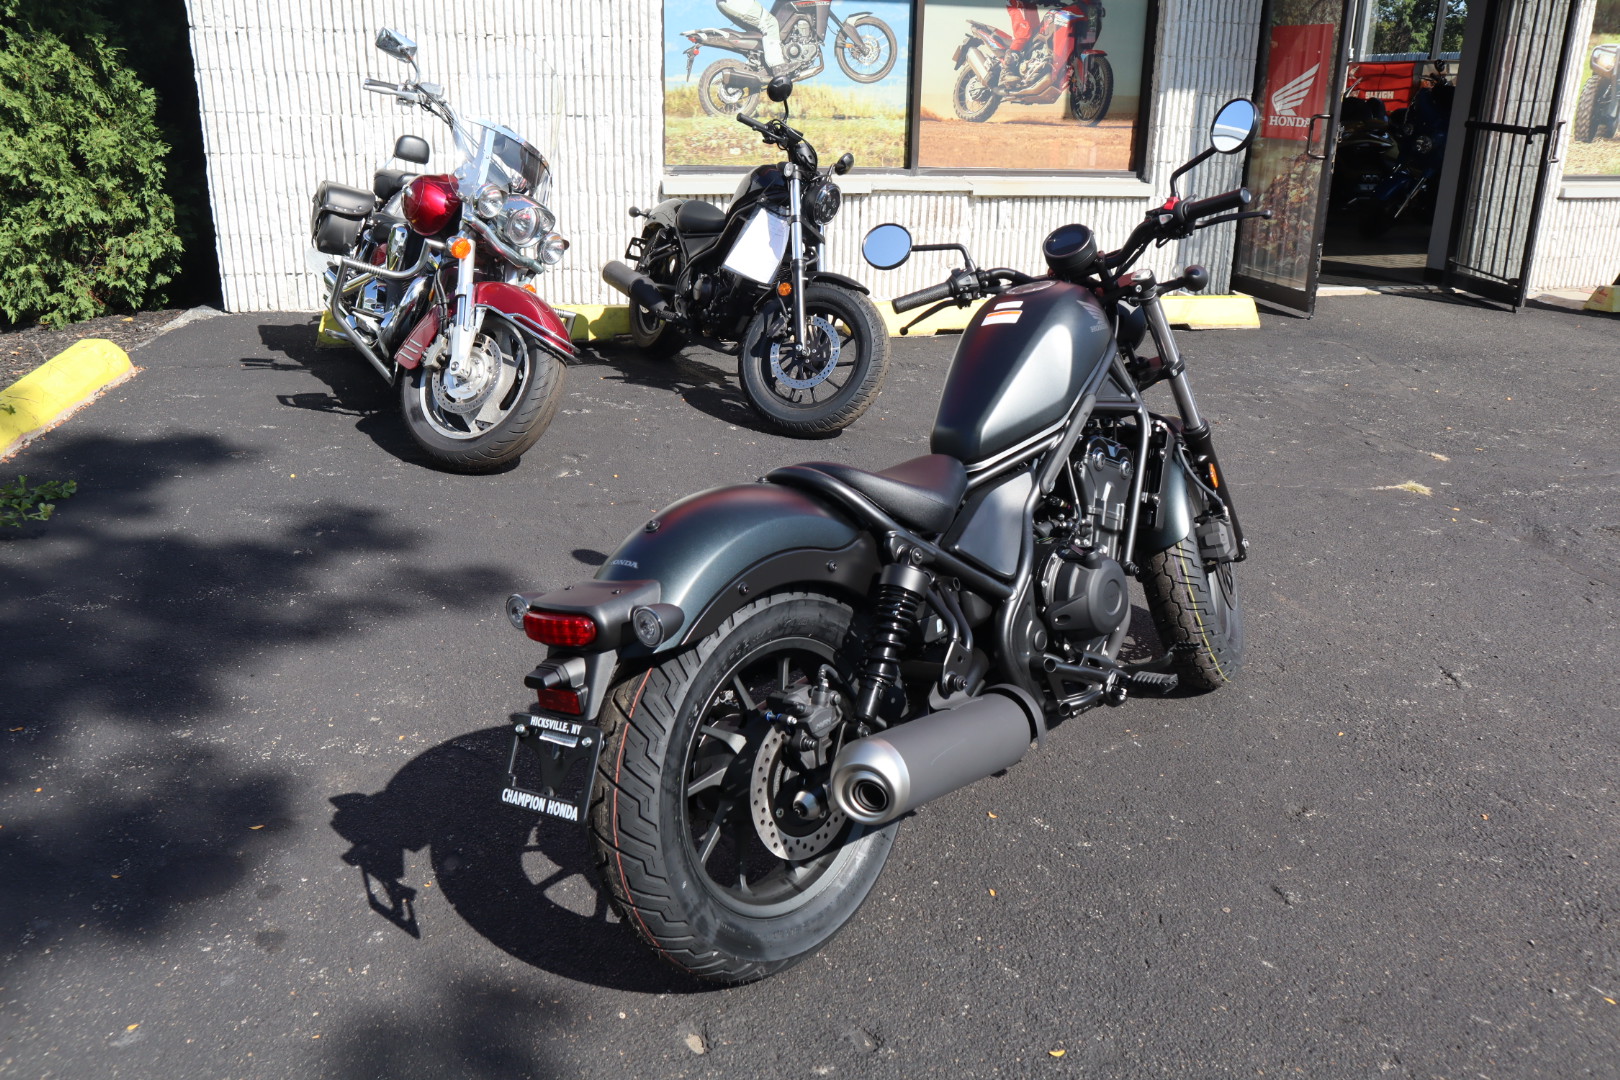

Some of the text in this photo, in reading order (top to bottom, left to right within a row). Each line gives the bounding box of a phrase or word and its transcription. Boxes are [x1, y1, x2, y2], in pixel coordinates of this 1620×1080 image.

[1365, 91, 1394, 99] SLEIGH
[1269, 115, 1311, 128] HONDA
[530, 715, 582, 735] HICKSVILLE, NY
[501, 788, 578, 821] CHAMPION HONDA
